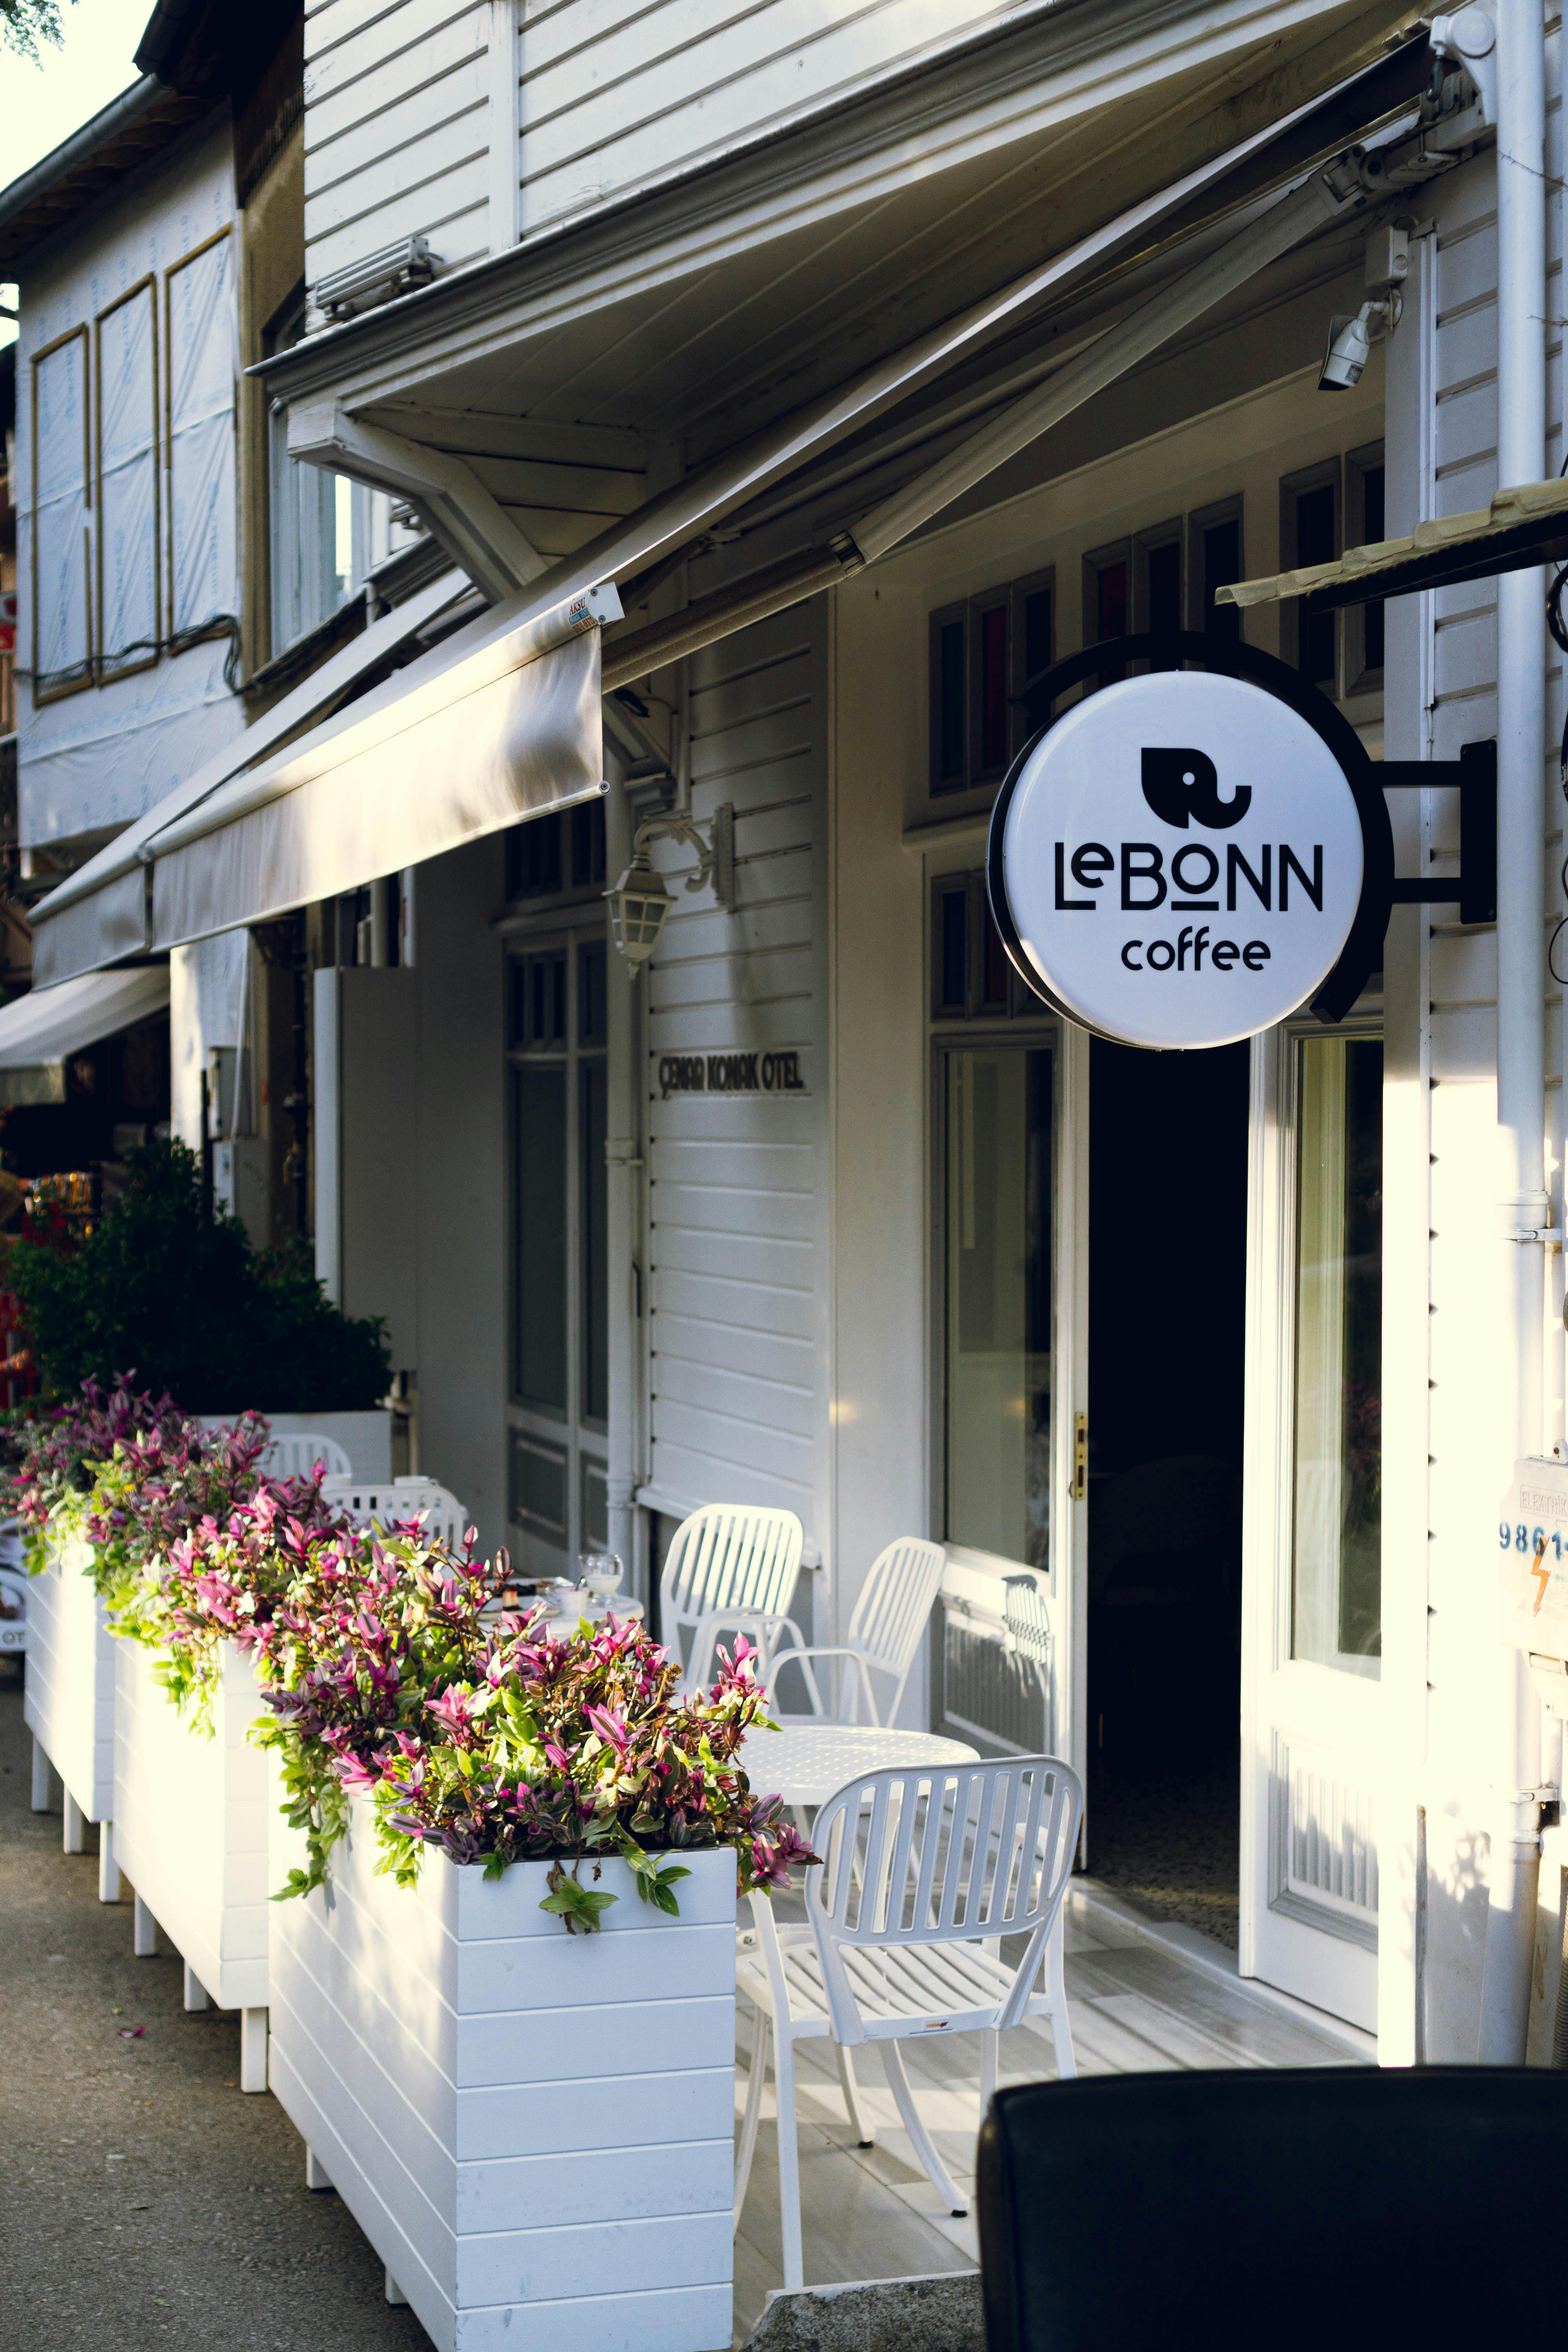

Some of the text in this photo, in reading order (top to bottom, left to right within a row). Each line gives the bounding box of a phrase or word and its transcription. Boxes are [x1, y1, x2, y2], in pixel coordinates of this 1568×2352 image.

[570, 597, 586, 615] AKSU
[1121, 926, 1271, 971] coffee
[762, 1051, 803, 1090] OTEL
[1499, 1521, 1568, 1562] 9861
